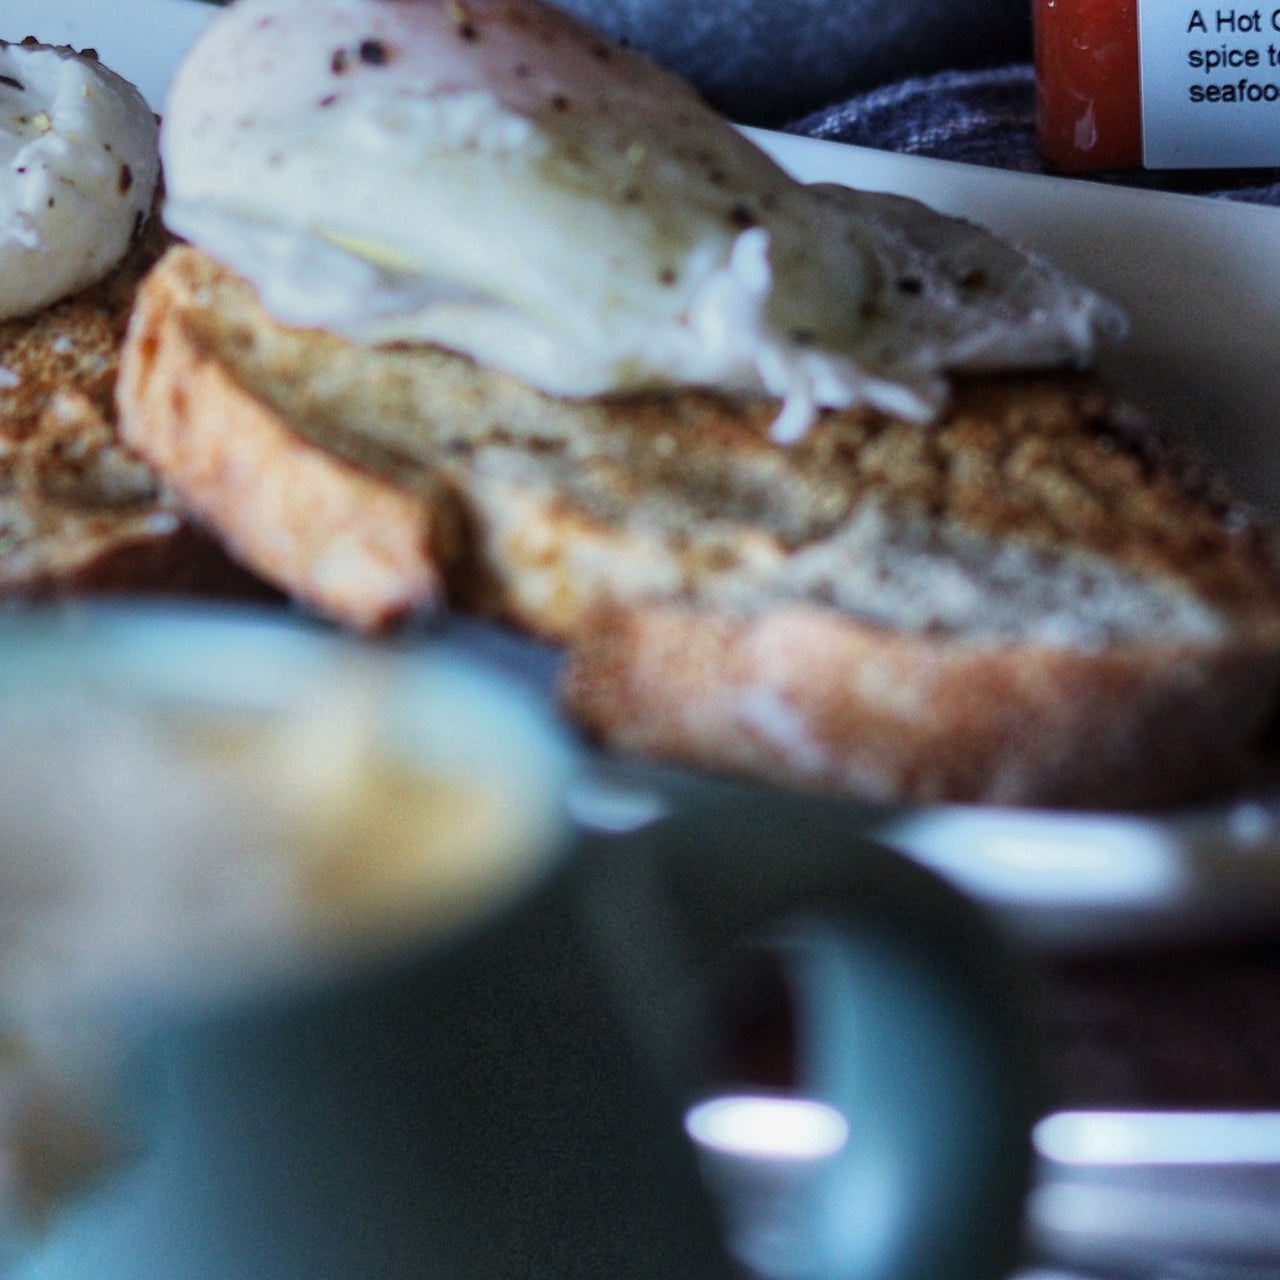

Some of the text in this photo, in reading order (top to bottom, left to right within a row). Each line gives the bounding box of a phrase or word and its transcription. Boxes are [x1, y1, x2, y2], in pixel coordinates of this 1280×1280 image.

[1187, 10, 1208, 34] A
[1216, 9, 1262, 33] Hot
[1188, 44, 1260, 73] spice
